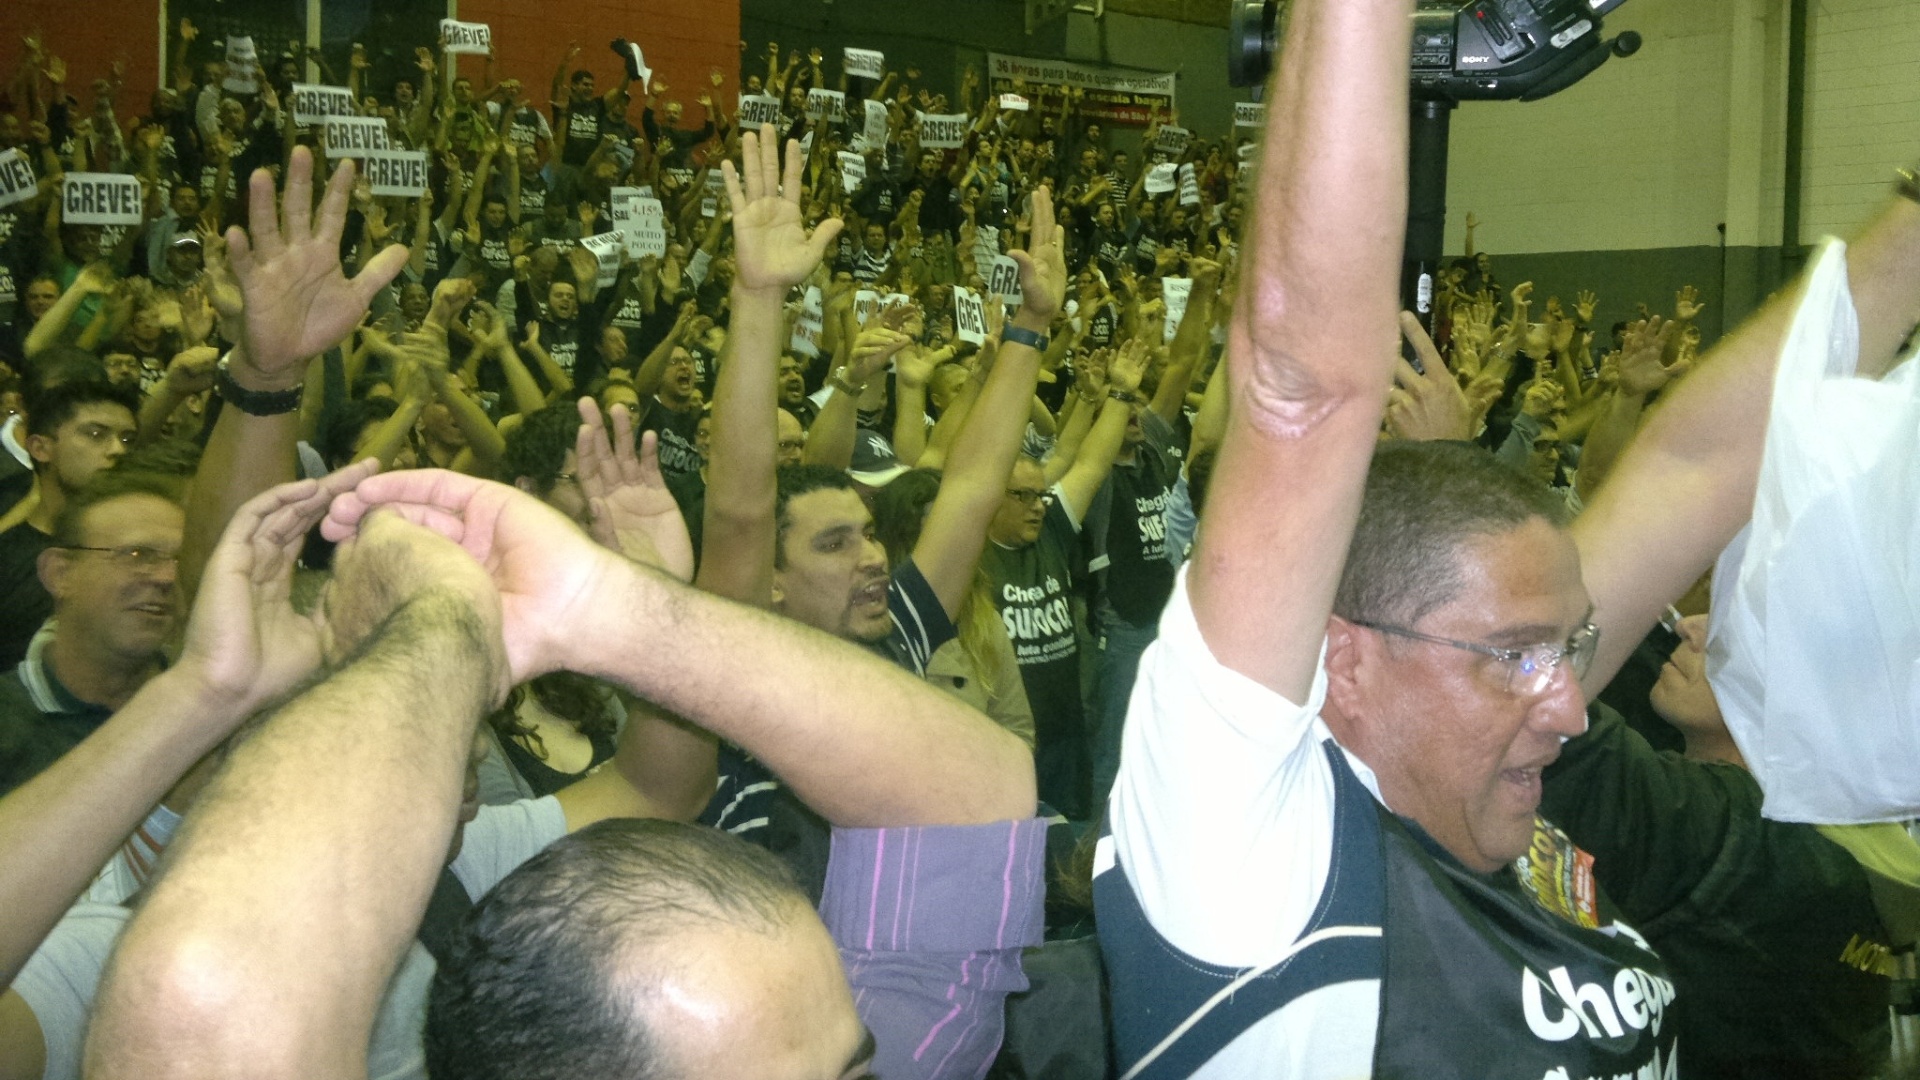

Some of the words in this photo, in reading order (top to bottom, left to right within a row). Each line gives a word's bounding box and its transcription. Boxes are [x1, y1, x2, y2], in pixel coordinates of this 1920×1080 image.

[442, 24, 490, 46] GREVE!
[996, 59, 1008, 73] 36
[1043, 68, 1064, 80] para
[1066, 69, 1086, 82] tudo
[327, 121, 389, 150] GREVE!
[921, 119, 964, 142] GREVE!
[366, 157, 429, 187] GREVE!
[66, 181, 139, 214] GREVE!
[631, 240, 663, 251] POUCO!
[633, 229, 661, 239] MUITO
[1046, 574, 1061, 594] de
